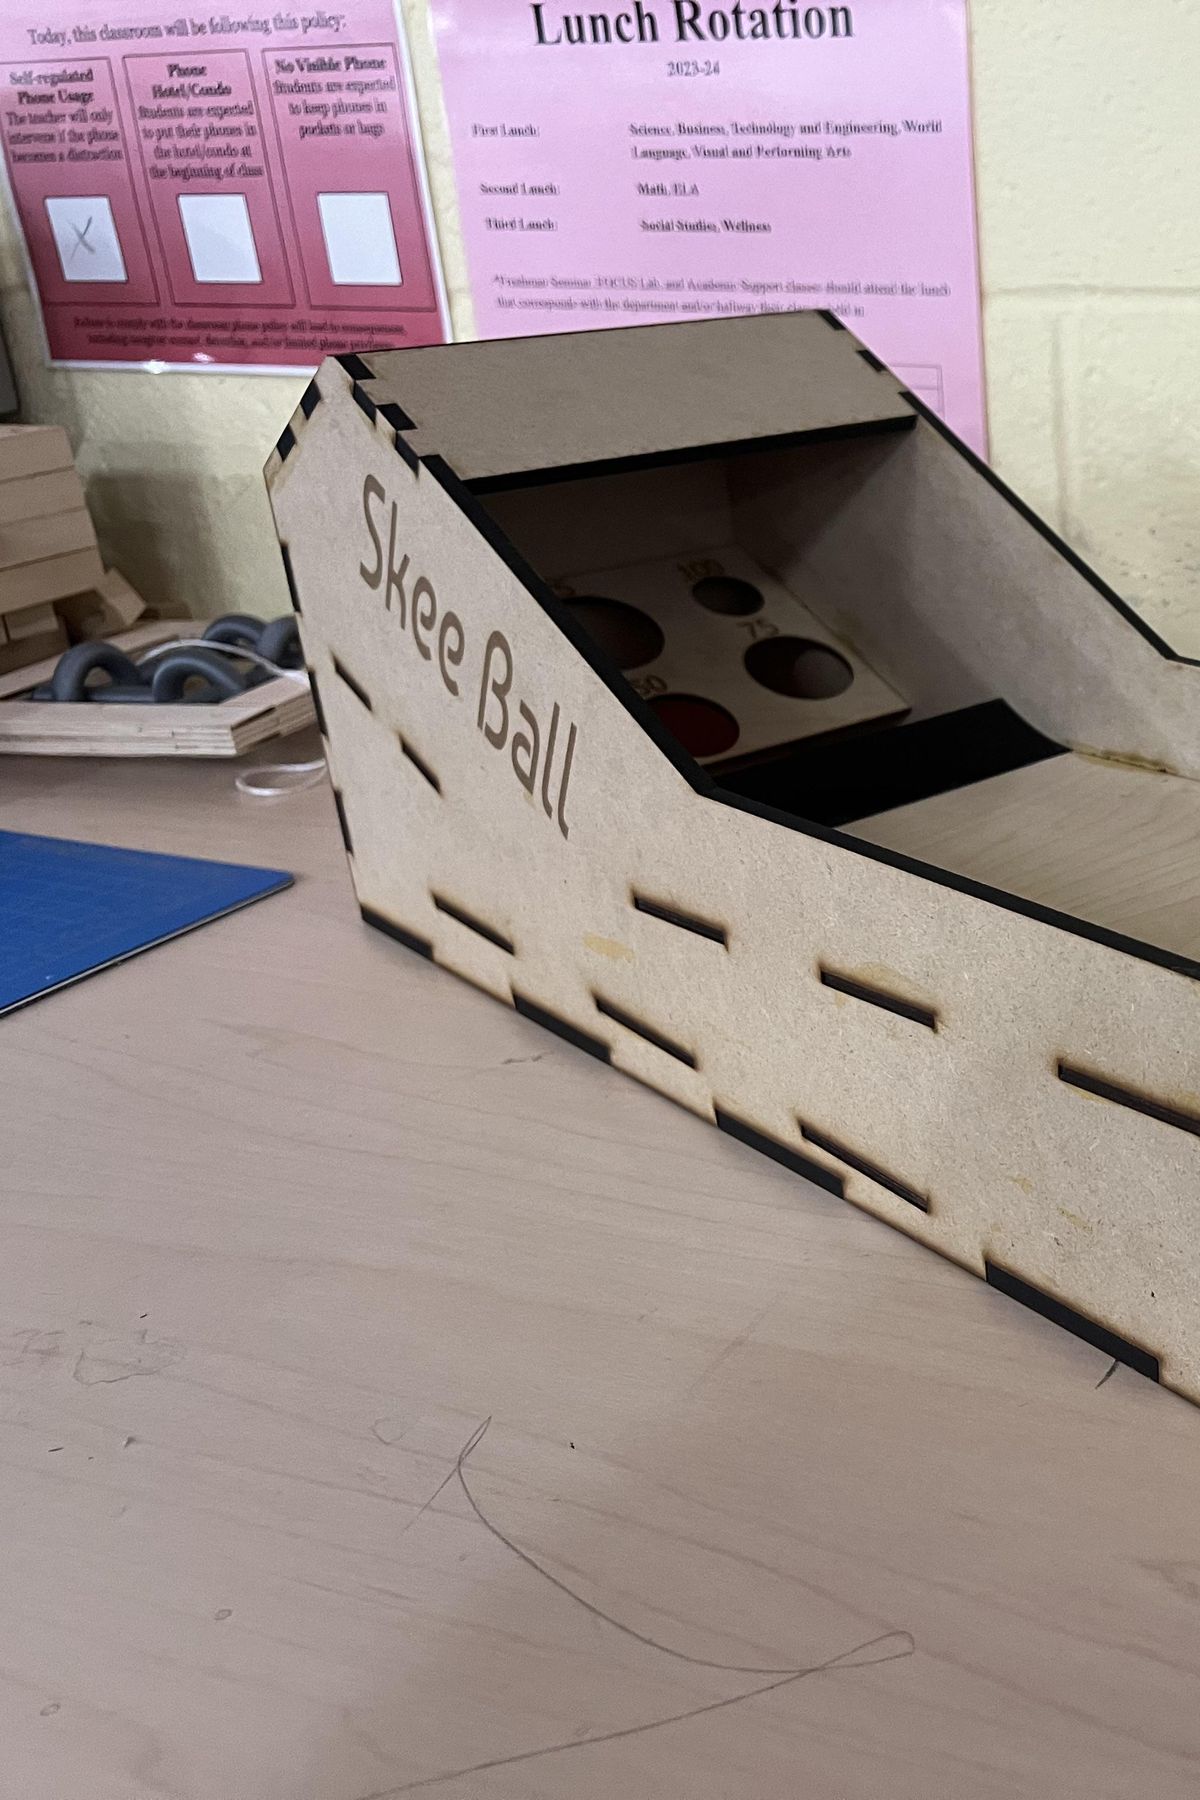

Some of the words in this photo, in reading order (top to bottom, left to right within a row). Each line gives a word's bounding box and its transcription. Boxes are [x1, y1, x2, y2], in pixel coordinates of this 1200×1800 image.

[27, 28, 72, 46] Today,
[72, 25, 97, 42] this
[99, 24, 162, 41] classroom
[164, 18, 188, 36] will
[190, 18, 207, 36] be
[209, 14, 272, 35] following
[272, 12, 299, 30] this
[528, 0, 660, 46] Lunch
[674, 0, 855, 42] Rotation
[167, 64, 207, 77] Phone
[274, 59, 295, 74] No
[295, 57, 341, 73] Visible
[344, 56, 386, 71] Phone
[666, 60, 720, 77] 2023-24
[9, 68, 94, 87] Self-regulated
[273, 79, 322, 95] Students
[326, 82, 343, 93] are
[345, 76, 396, 96] expected
[17, 91, 56, 105] Phone
[57, 89, 94, 106] Usage
[152, 81, 232, 100] Hotel/Condo
[5, 111, 27, 126] The
[28, 110, 66, 124] teacher
[69, 108, 89, 123] will
[90, 108, 113, 125] only
[138, 105, 184, 120] Students
[187, 106, 206, 118] are
[207, 101, 254, 119] expected
[288, 102, 302, 115] to
[303, 99, 330, 118] keep
[332, 99, 373, 117] phones
[375, 99, 387, 113] in
[8, 131, 56, 144] intervene
[58, 129, 66, 143] if
[67, 129, 86, 142] the
[87, 128, 119, 145] phone
[142, 127, 155, 139] to
[155, 126, 173, 141] put
[175, 124, 201, 138] their
[204, 123, 242, 140] phones
[245, 123, 257, 136] in
[300, 121, 342, 139] pockets
[343, 124, 356, 135] or
[357, 120, 385, 138] bags
[472, 123, 498, 137] First
[501, 123, 540, 137] Lunch:
[731, 121, 796, 139] Technology
[799, 121, 821, 134] and
[903, 120, 942, 133] World
[12, 150, 57, 163] becomes
[58, 152, 66, 162] a
[67, 149, 123, 161] distraction
[154, 145, 172, 160] the
[240, 146, 252, 157] at
[692, 145, 729, 158] Visual
[731, 145, 753, 158] and
[756, 145, 822, 161] Performing
[827, 144, 852, 157] Arts
[150, 165, 167, 179] the
[168, 163, 222, 181] beginning
[223, 163, 236, 178] of
[237, 164, 264, 178] class
[480, 183, 518, 195] Second
[673, 182, 700, 195] ELA
[485, 217, 516, 231] Third
[640, 219, 674, 232] Social
[721, 219, 772, 233] Wellness
[359, 474, 466, 697] Skee
[477, 630, 577, 840] Ball
